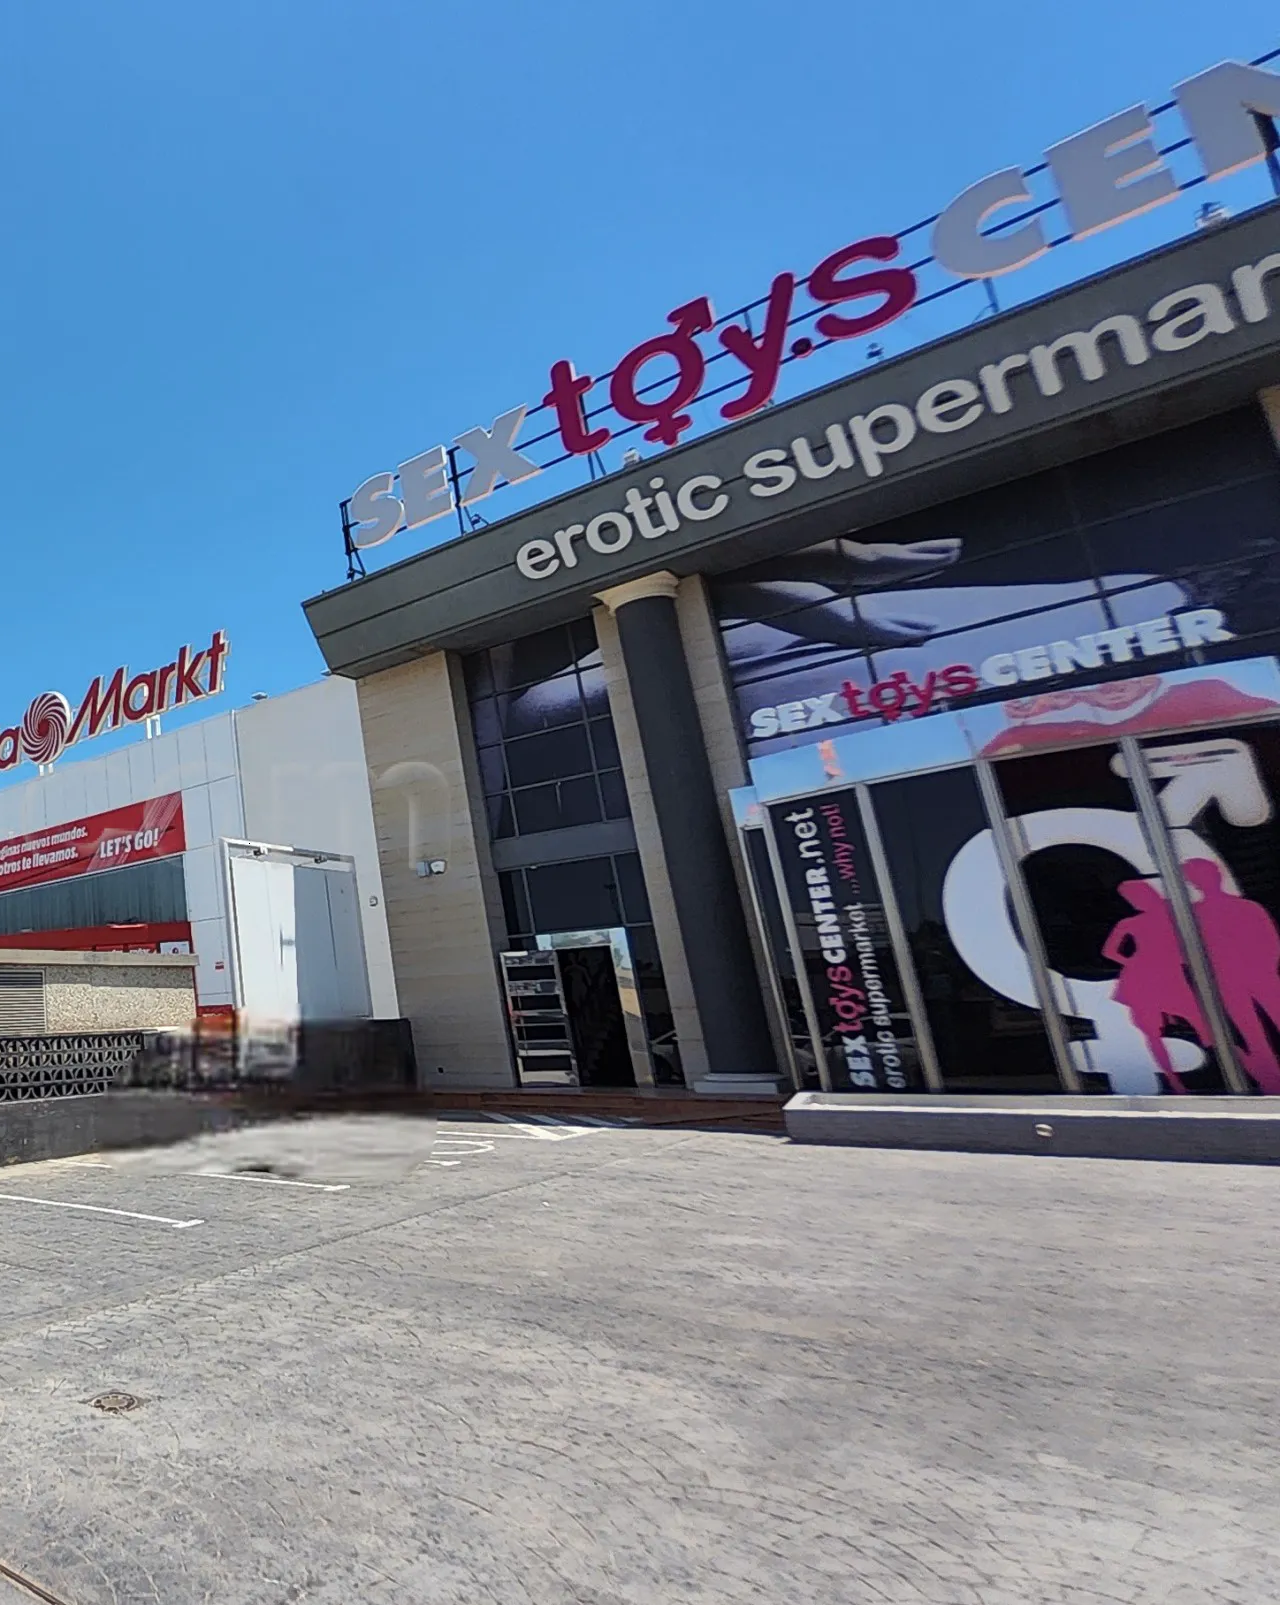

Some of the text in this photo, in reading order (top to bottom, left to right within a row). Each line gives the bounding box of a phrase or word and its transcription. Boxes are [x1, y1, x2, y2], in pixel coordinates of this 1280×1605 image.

[349, 403, 542, 549] SEX
[516, 476, 729, 580] erotic
[979, 608, 1235, 687] CENTER
[65, 629, 231, 747] Markt
[21, 836, 51, 854] nuevos
[51, 825, 89, 845] mundos.
[22, 857, 32, 870] te
[32, 846, 79, 868] llevamos.
[99, 828, 160, 860] LET'S GO!
